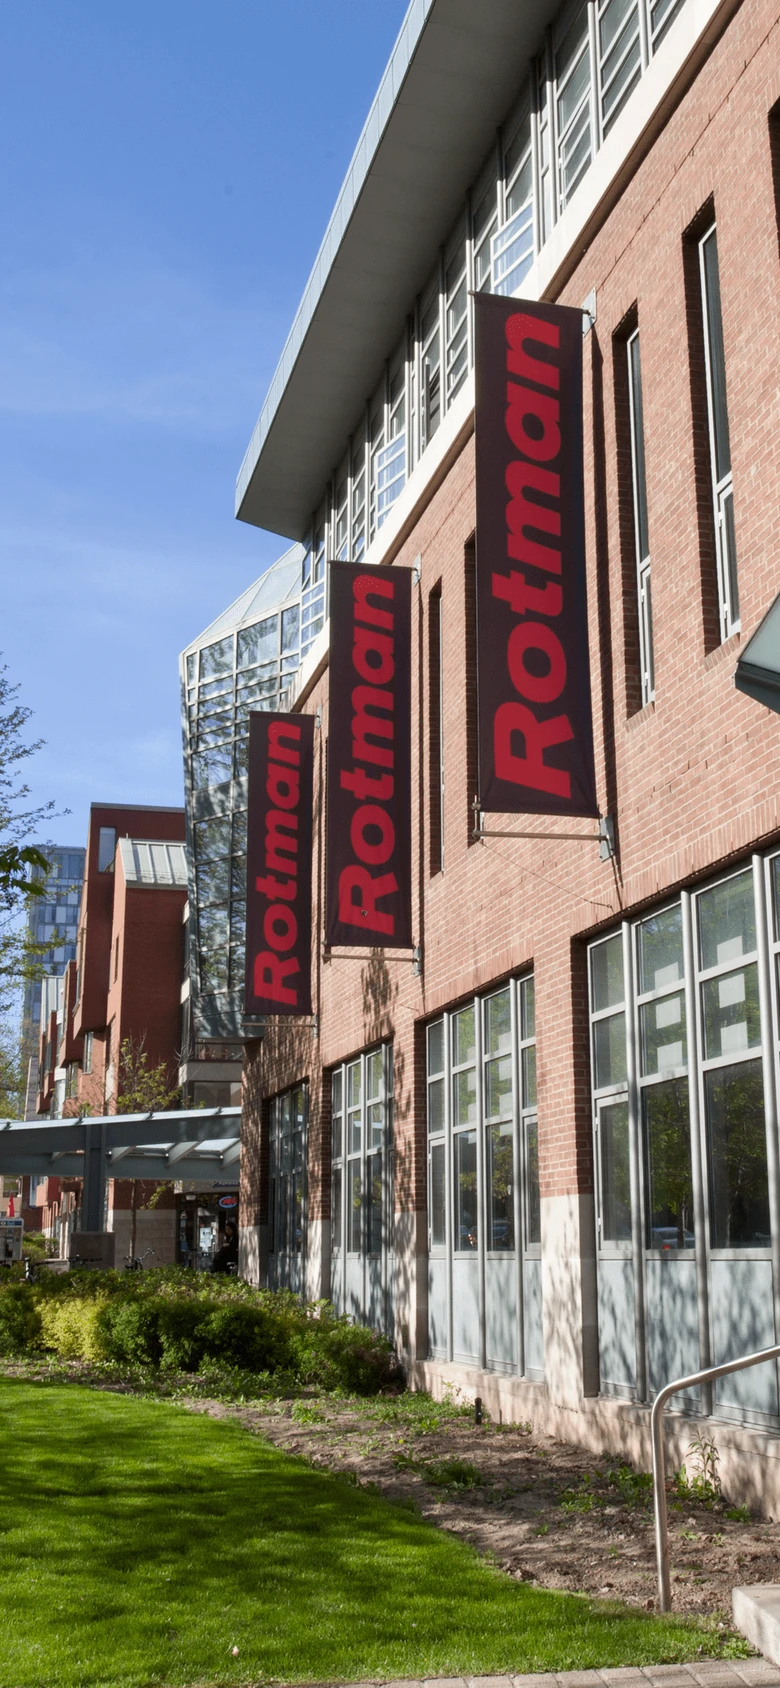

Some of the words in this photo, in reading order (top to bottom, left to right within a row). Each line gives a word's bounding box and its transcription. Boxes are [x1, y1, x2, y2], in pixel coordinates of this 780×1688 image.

[491, 312, 574, 799] Rotman
[253, 720, 301, 1006] Rotman
[338, 574, 398, 936] Rotman
